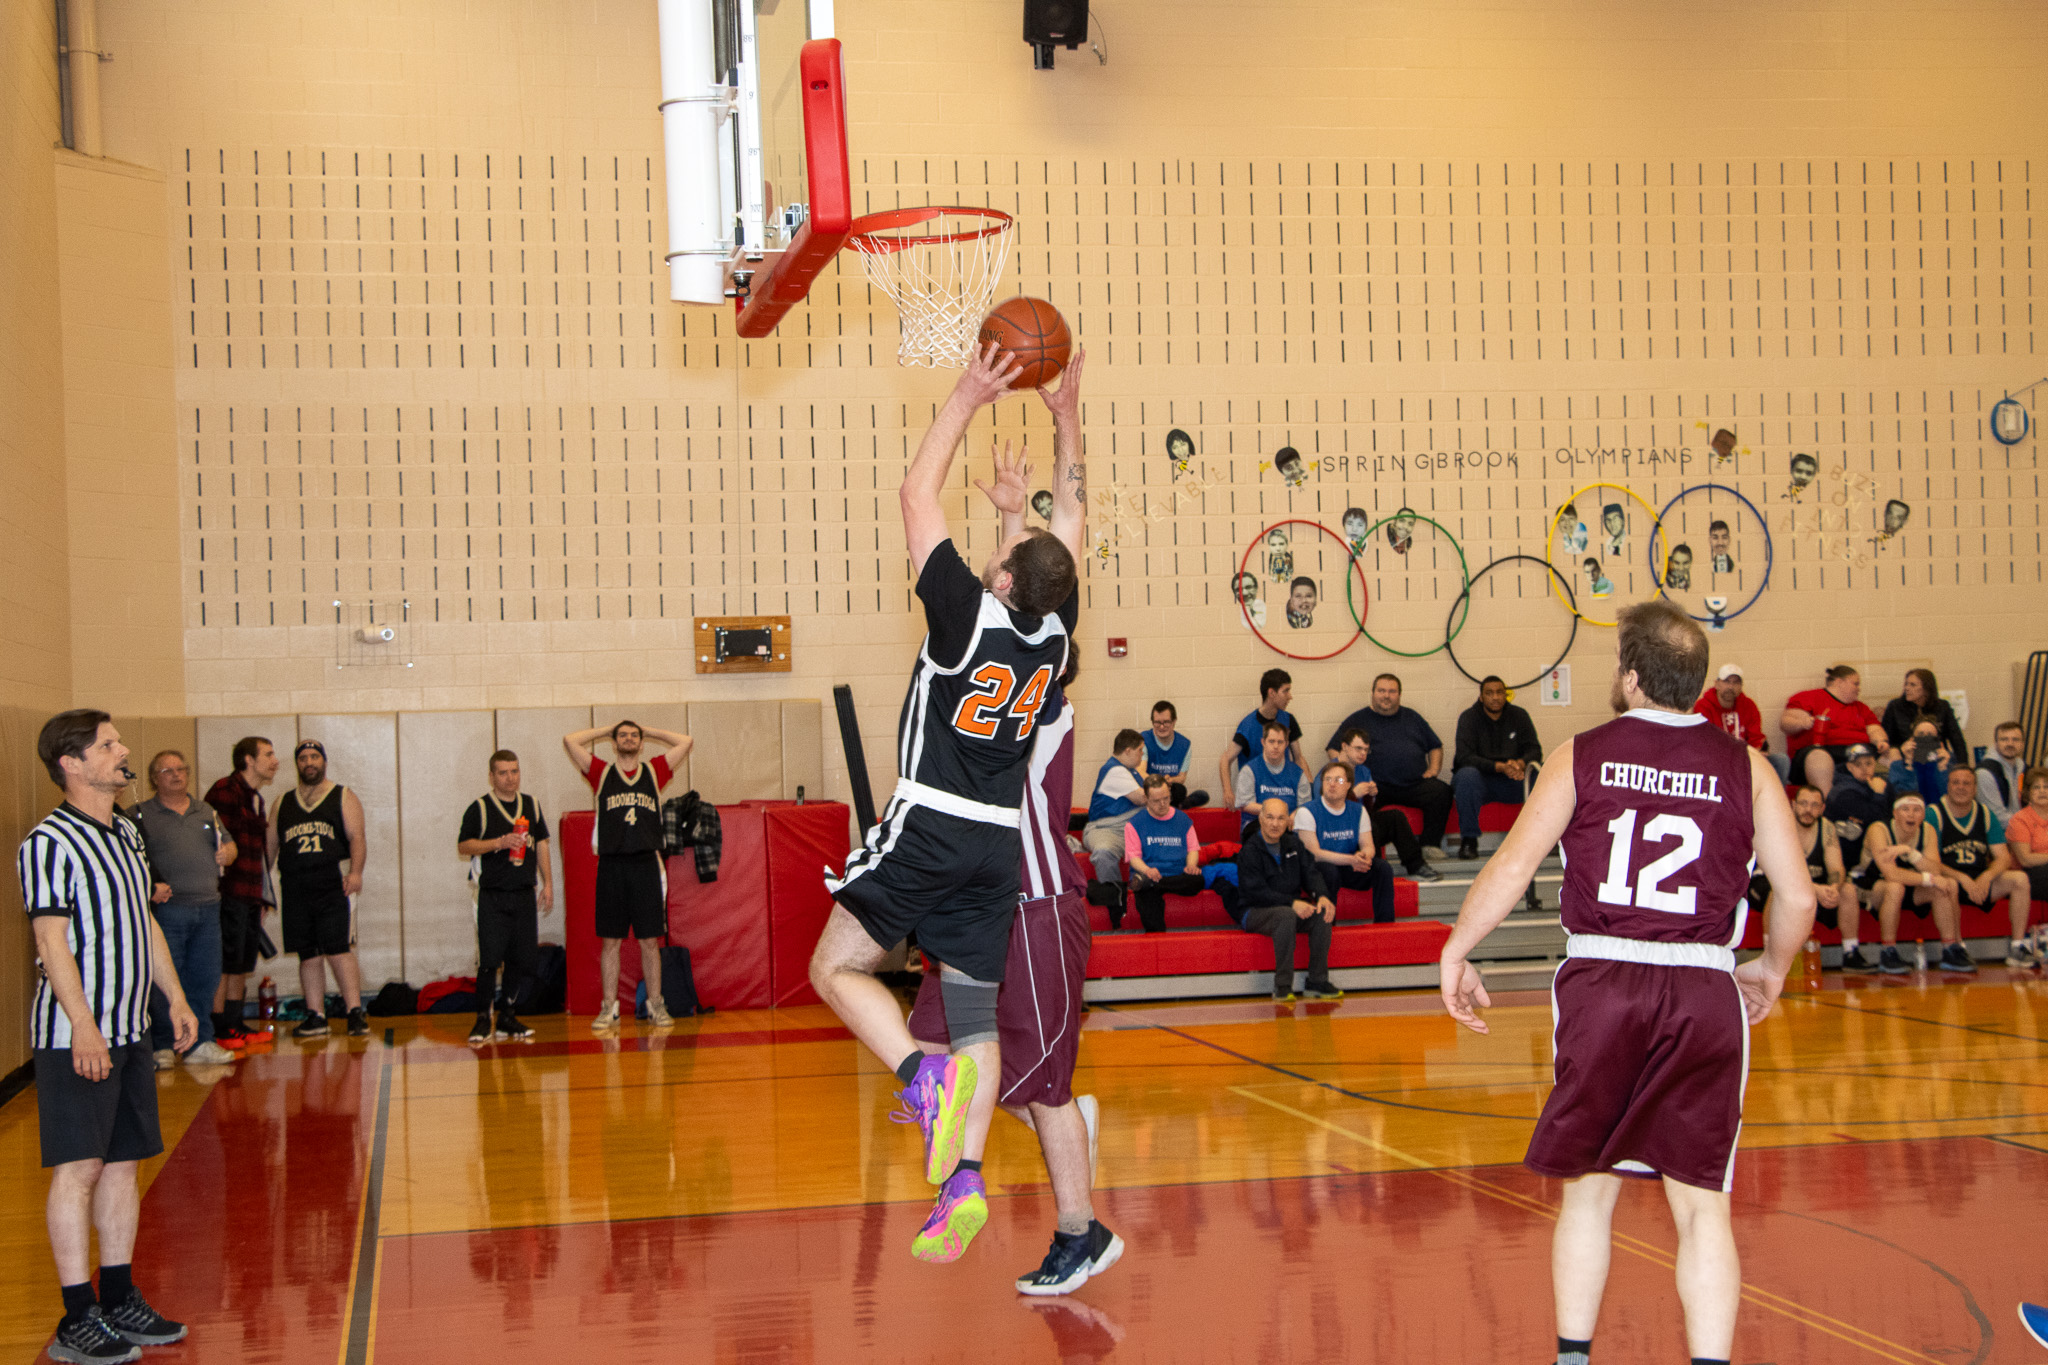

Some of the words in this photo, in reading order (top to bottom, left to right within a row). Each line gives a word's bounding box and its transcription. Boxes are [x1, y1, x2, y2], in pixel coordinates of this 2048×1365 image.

[1556, 448, 1692, 465] OLYMPIANS
[951, 661, 1053, 741] 24
[1600, 761, 1723, 803] CHURCHILL
[624, 807, 637, 825] 4
[298, 835, 323, 853] 21
[1597, 808, 1704, 915] 12
[1955, 848, 1976, 864] 15
